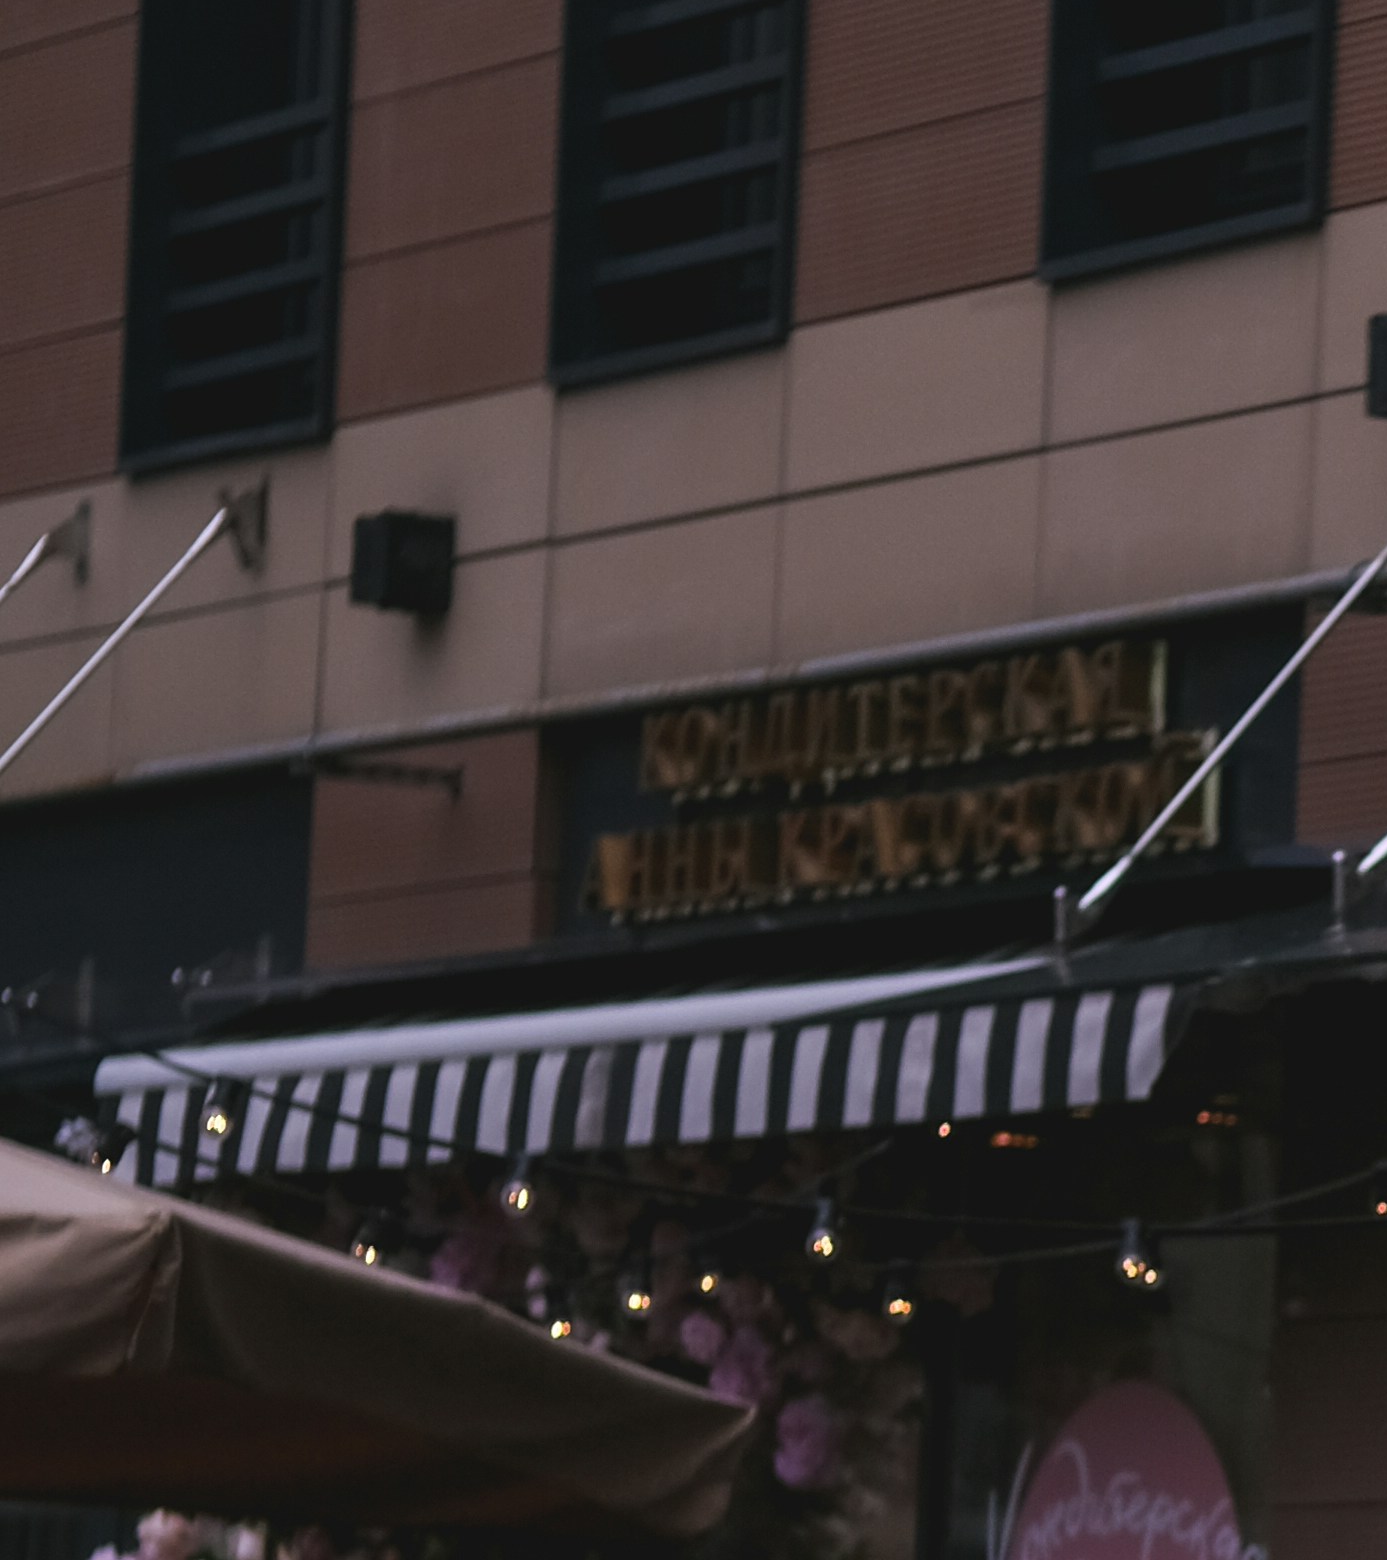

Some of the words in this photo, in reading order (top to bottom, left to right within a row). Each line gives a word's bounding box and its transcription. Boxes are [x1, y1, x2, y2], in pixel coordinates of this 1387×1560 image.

[641, 638, 1165, 800] КОНДИТЕРСКАЯ
[580, 814, 774, 926] АННЫ
[778, 728, 1219, 904] КРАСОВСКОЙ
